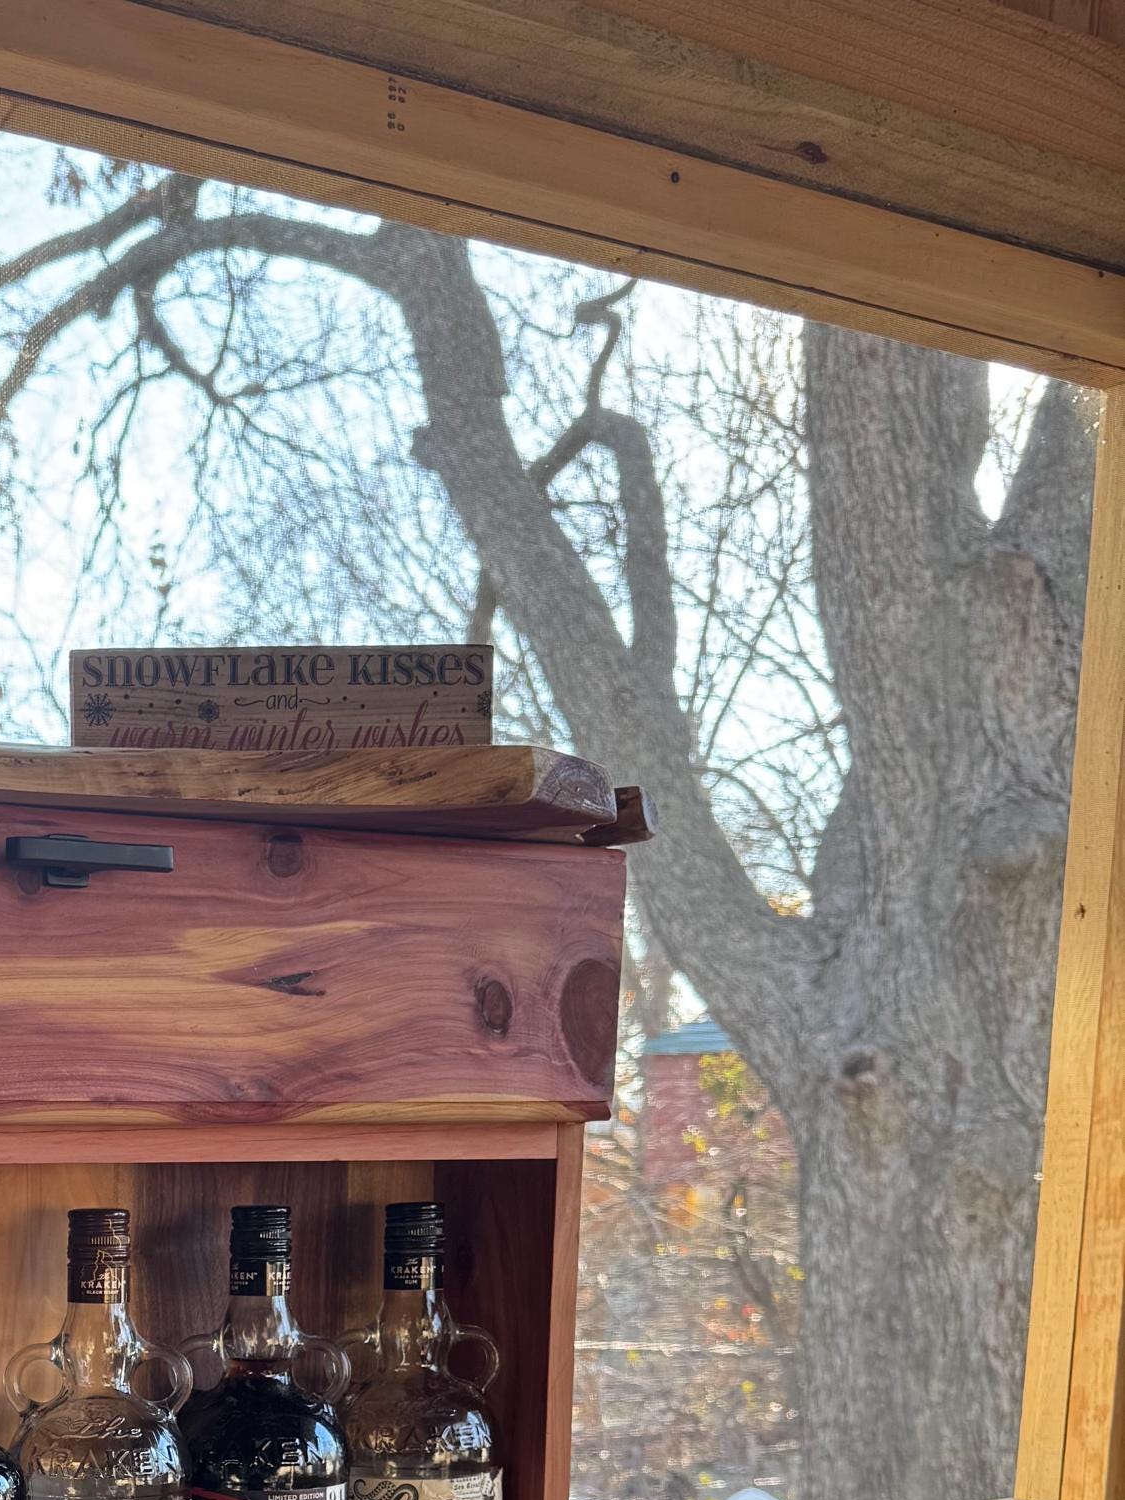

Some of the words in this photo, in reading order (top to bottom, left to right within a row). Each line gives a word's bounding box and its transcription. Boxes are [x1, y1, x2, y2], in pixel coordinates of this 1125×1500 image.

[266, 687, 299, 710] and
[109, 721, 217, 749] warm
[227, 707, 336, 750] winter
[351, 700, 465, 748] wishes
[299, 1492, 324, 1500] EDITION
